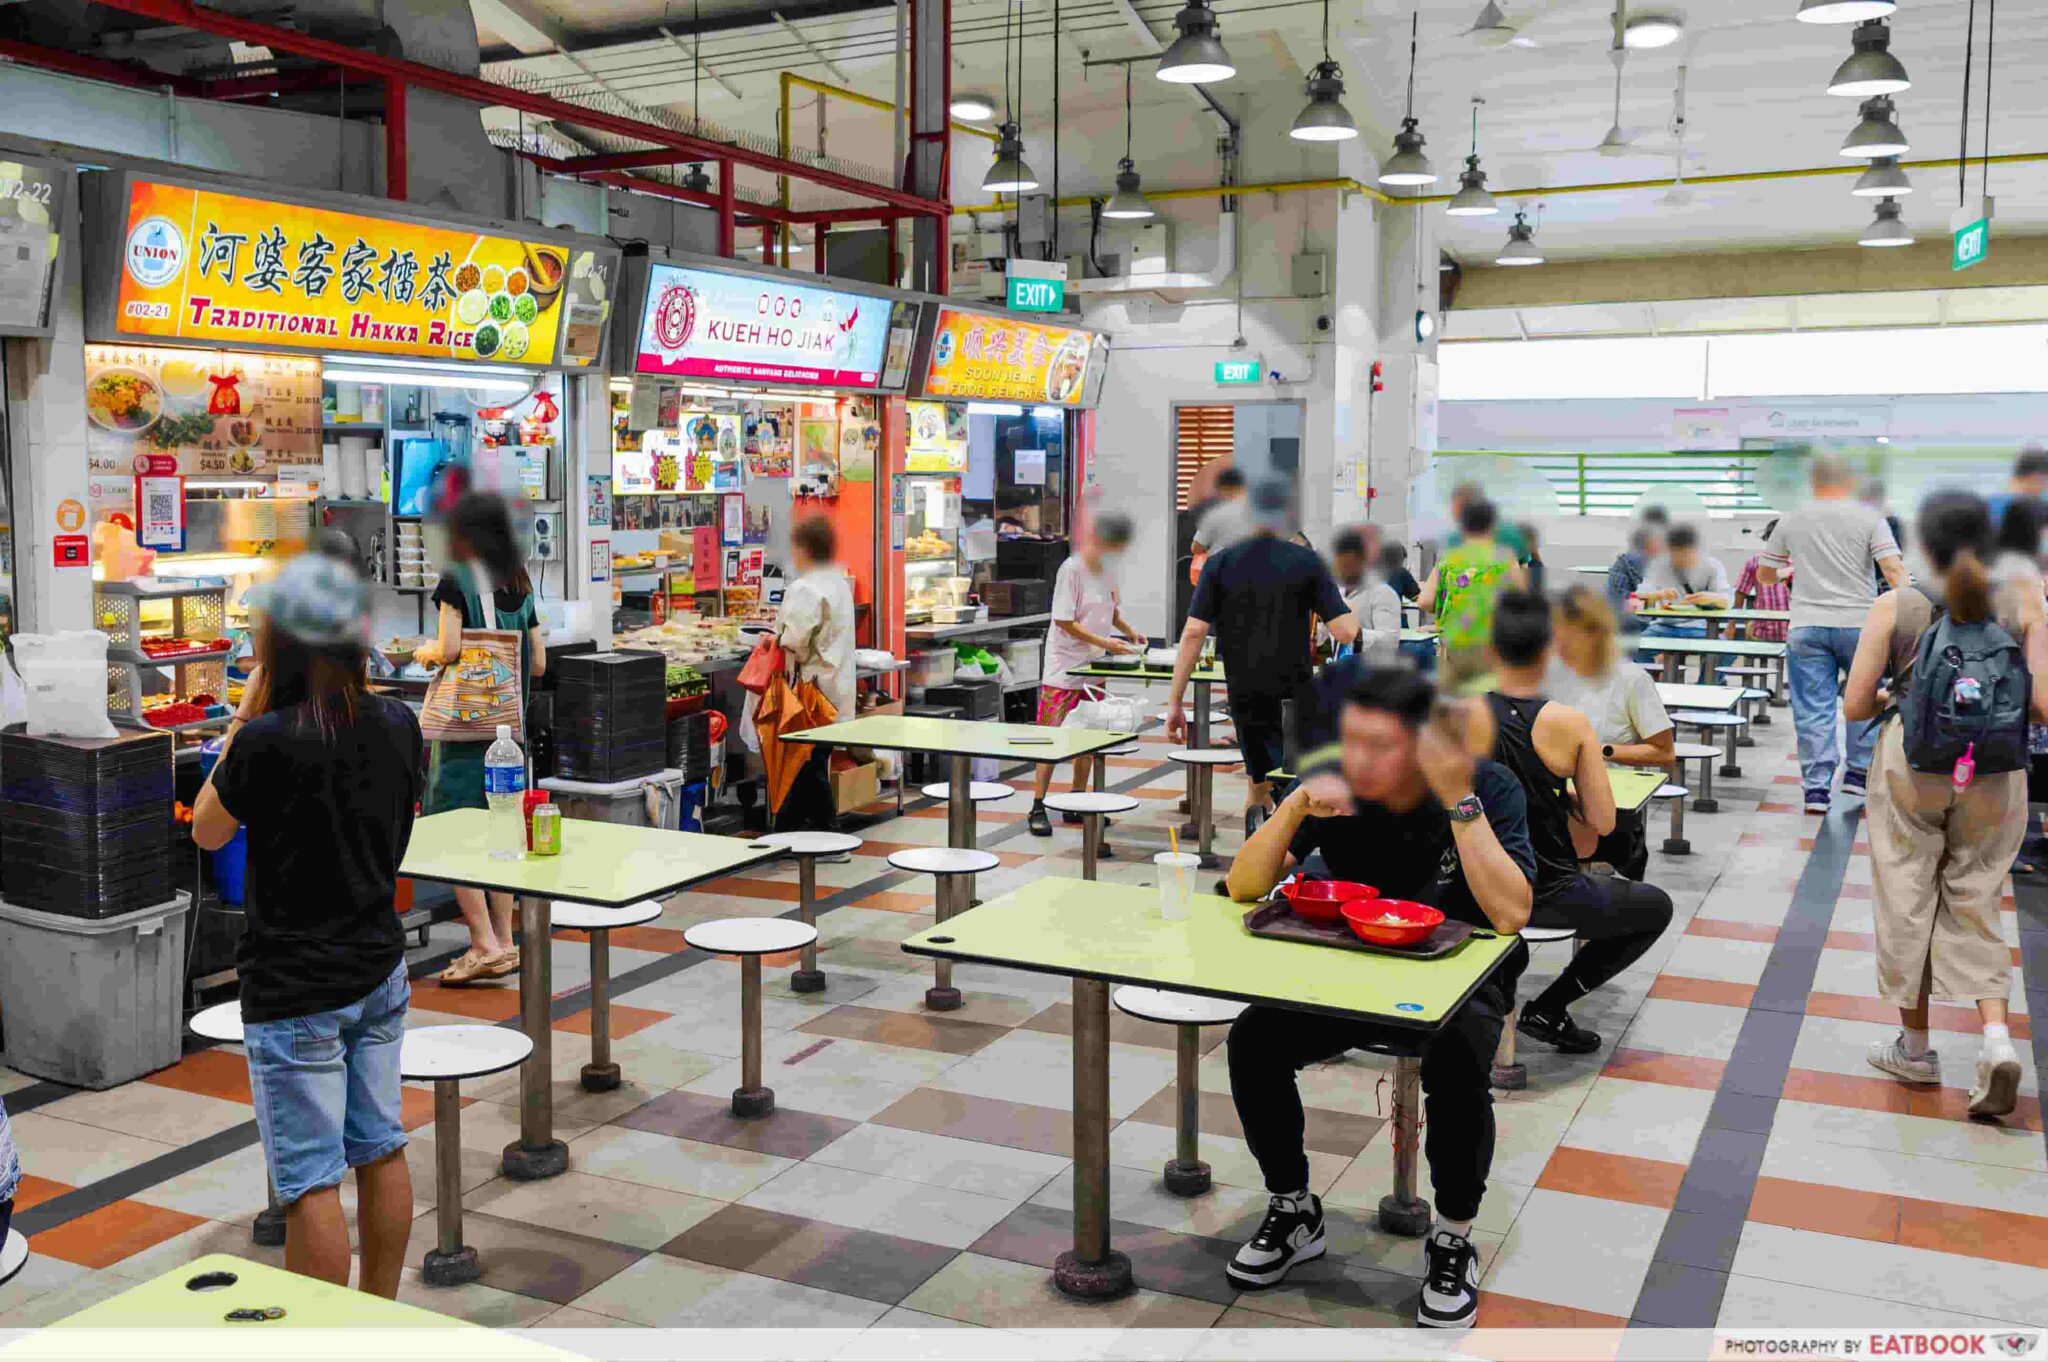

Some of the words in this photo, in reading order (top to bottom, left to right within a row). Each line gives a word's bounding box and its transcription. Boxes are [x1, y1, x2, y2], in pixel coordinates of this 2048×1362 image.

[133, 245, 177, 260] UNION
[1962, 227, 1983, 261] EXIT
[200, 222, 458, 311] 河婆客家擂茶
[1016, 282, 1048, 306] EXIT
[127, 302, 168, 317] #02-21
[190, 298, 338, 336] TRADITIONAL
[350, 314, 418, 342] HAKKA
[428, 322, 473, 347] RICE
[708, 320, 760, 343] KUEH
[767, 327, 793, 346] HO
[798, 331, 836, 351] JIAK
[965, 367, 1002, 382] SOON
[1223, 364, 1250, 380] EXIT
[951, 382, 985, 397] FOOD
[990, 385, 1047, 400] DELIGHTS
[89, 458, 115, 469] $4.00
[200, 459, 225, 471] $4.50
